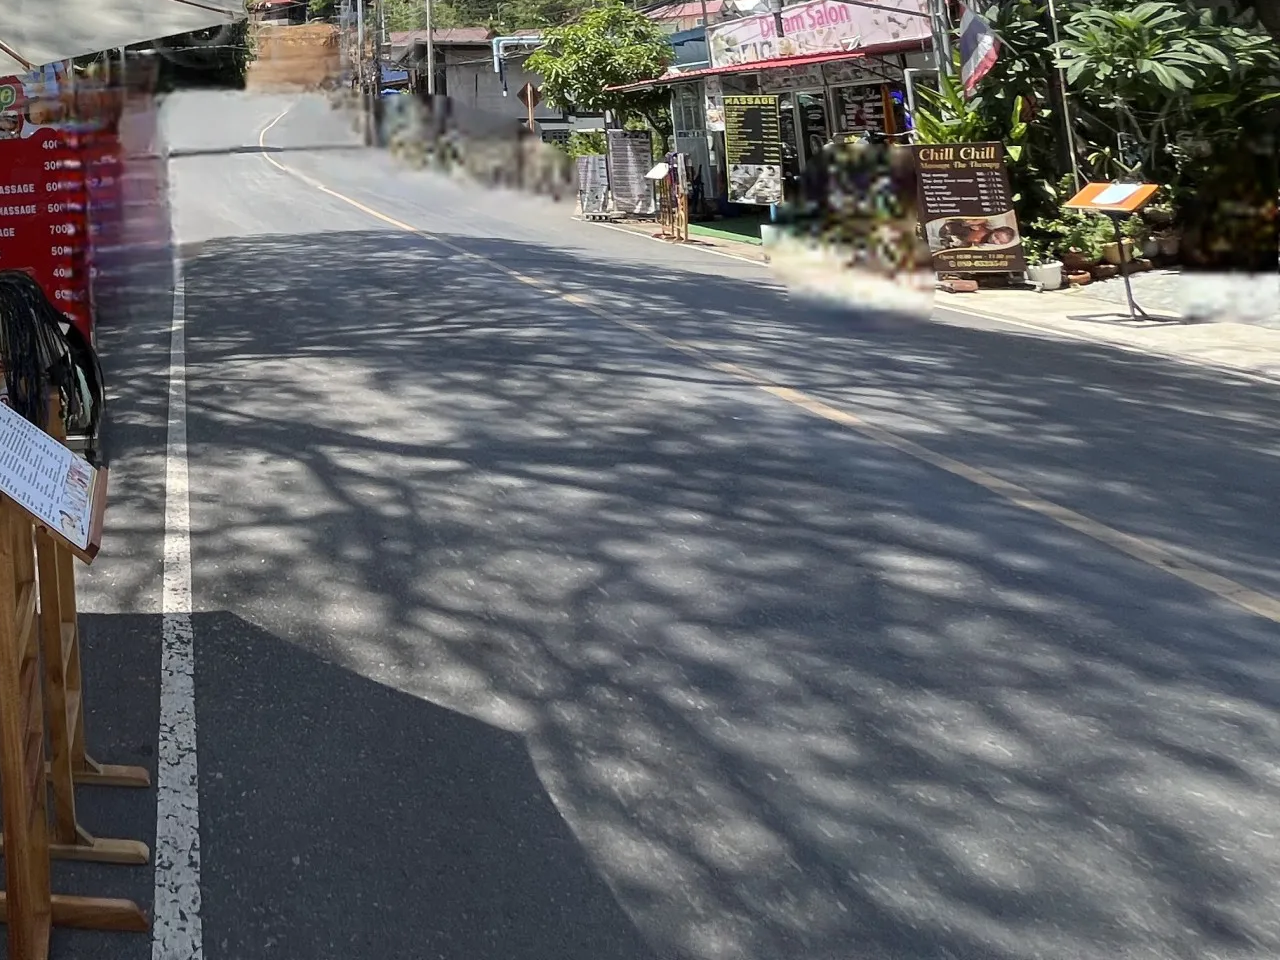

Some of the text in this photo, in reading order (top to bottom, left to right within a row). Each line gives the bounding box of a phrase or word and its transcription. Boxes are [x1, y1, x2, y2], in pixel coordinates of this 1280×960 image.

[806, 2, 851, 29] Salon
[725, 97, 775, 105] MASSAGE
[920, 147, 995, 160] Chill Chill
